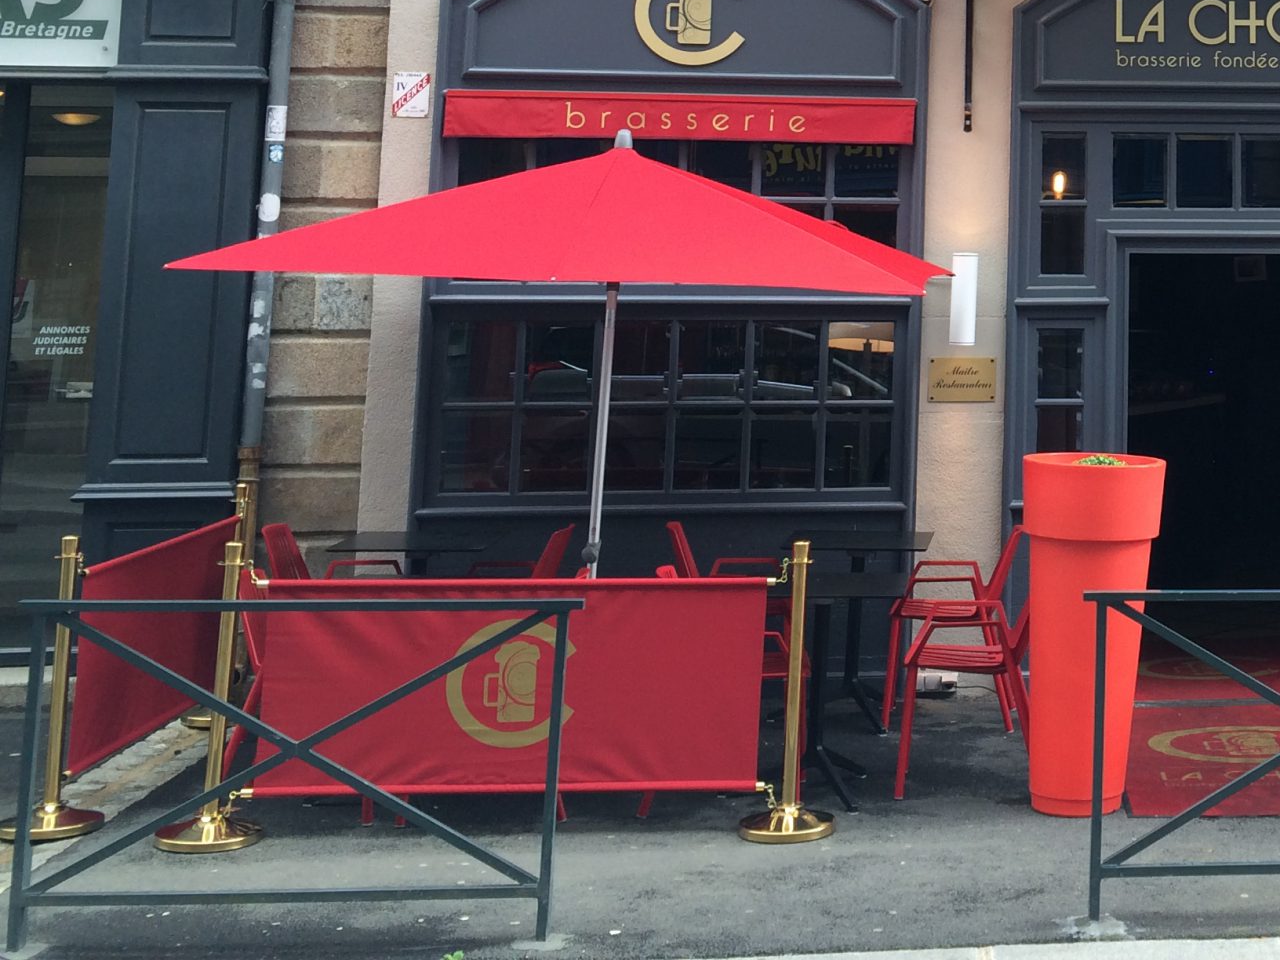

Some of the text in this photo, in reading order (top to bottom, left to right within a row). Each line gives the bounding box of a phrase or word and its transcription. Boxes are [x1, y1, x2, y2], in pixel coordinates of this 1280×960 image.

[1, 21, 93, 40] Bretagne
[1116, 49, 1202, 68] brasserie
[1213, 50, 1279, 69] fondée
[396, 81, 408, 91] IV
[394, 75, 430, 112] LICENCE
[564, 101, 807, 133] brasserie
[40, 326, 91, 334] ANNONCES
[33, 336, 88, 345] JUDICIAIRES
[35, 345, 84, 355] ET LÉGALES
